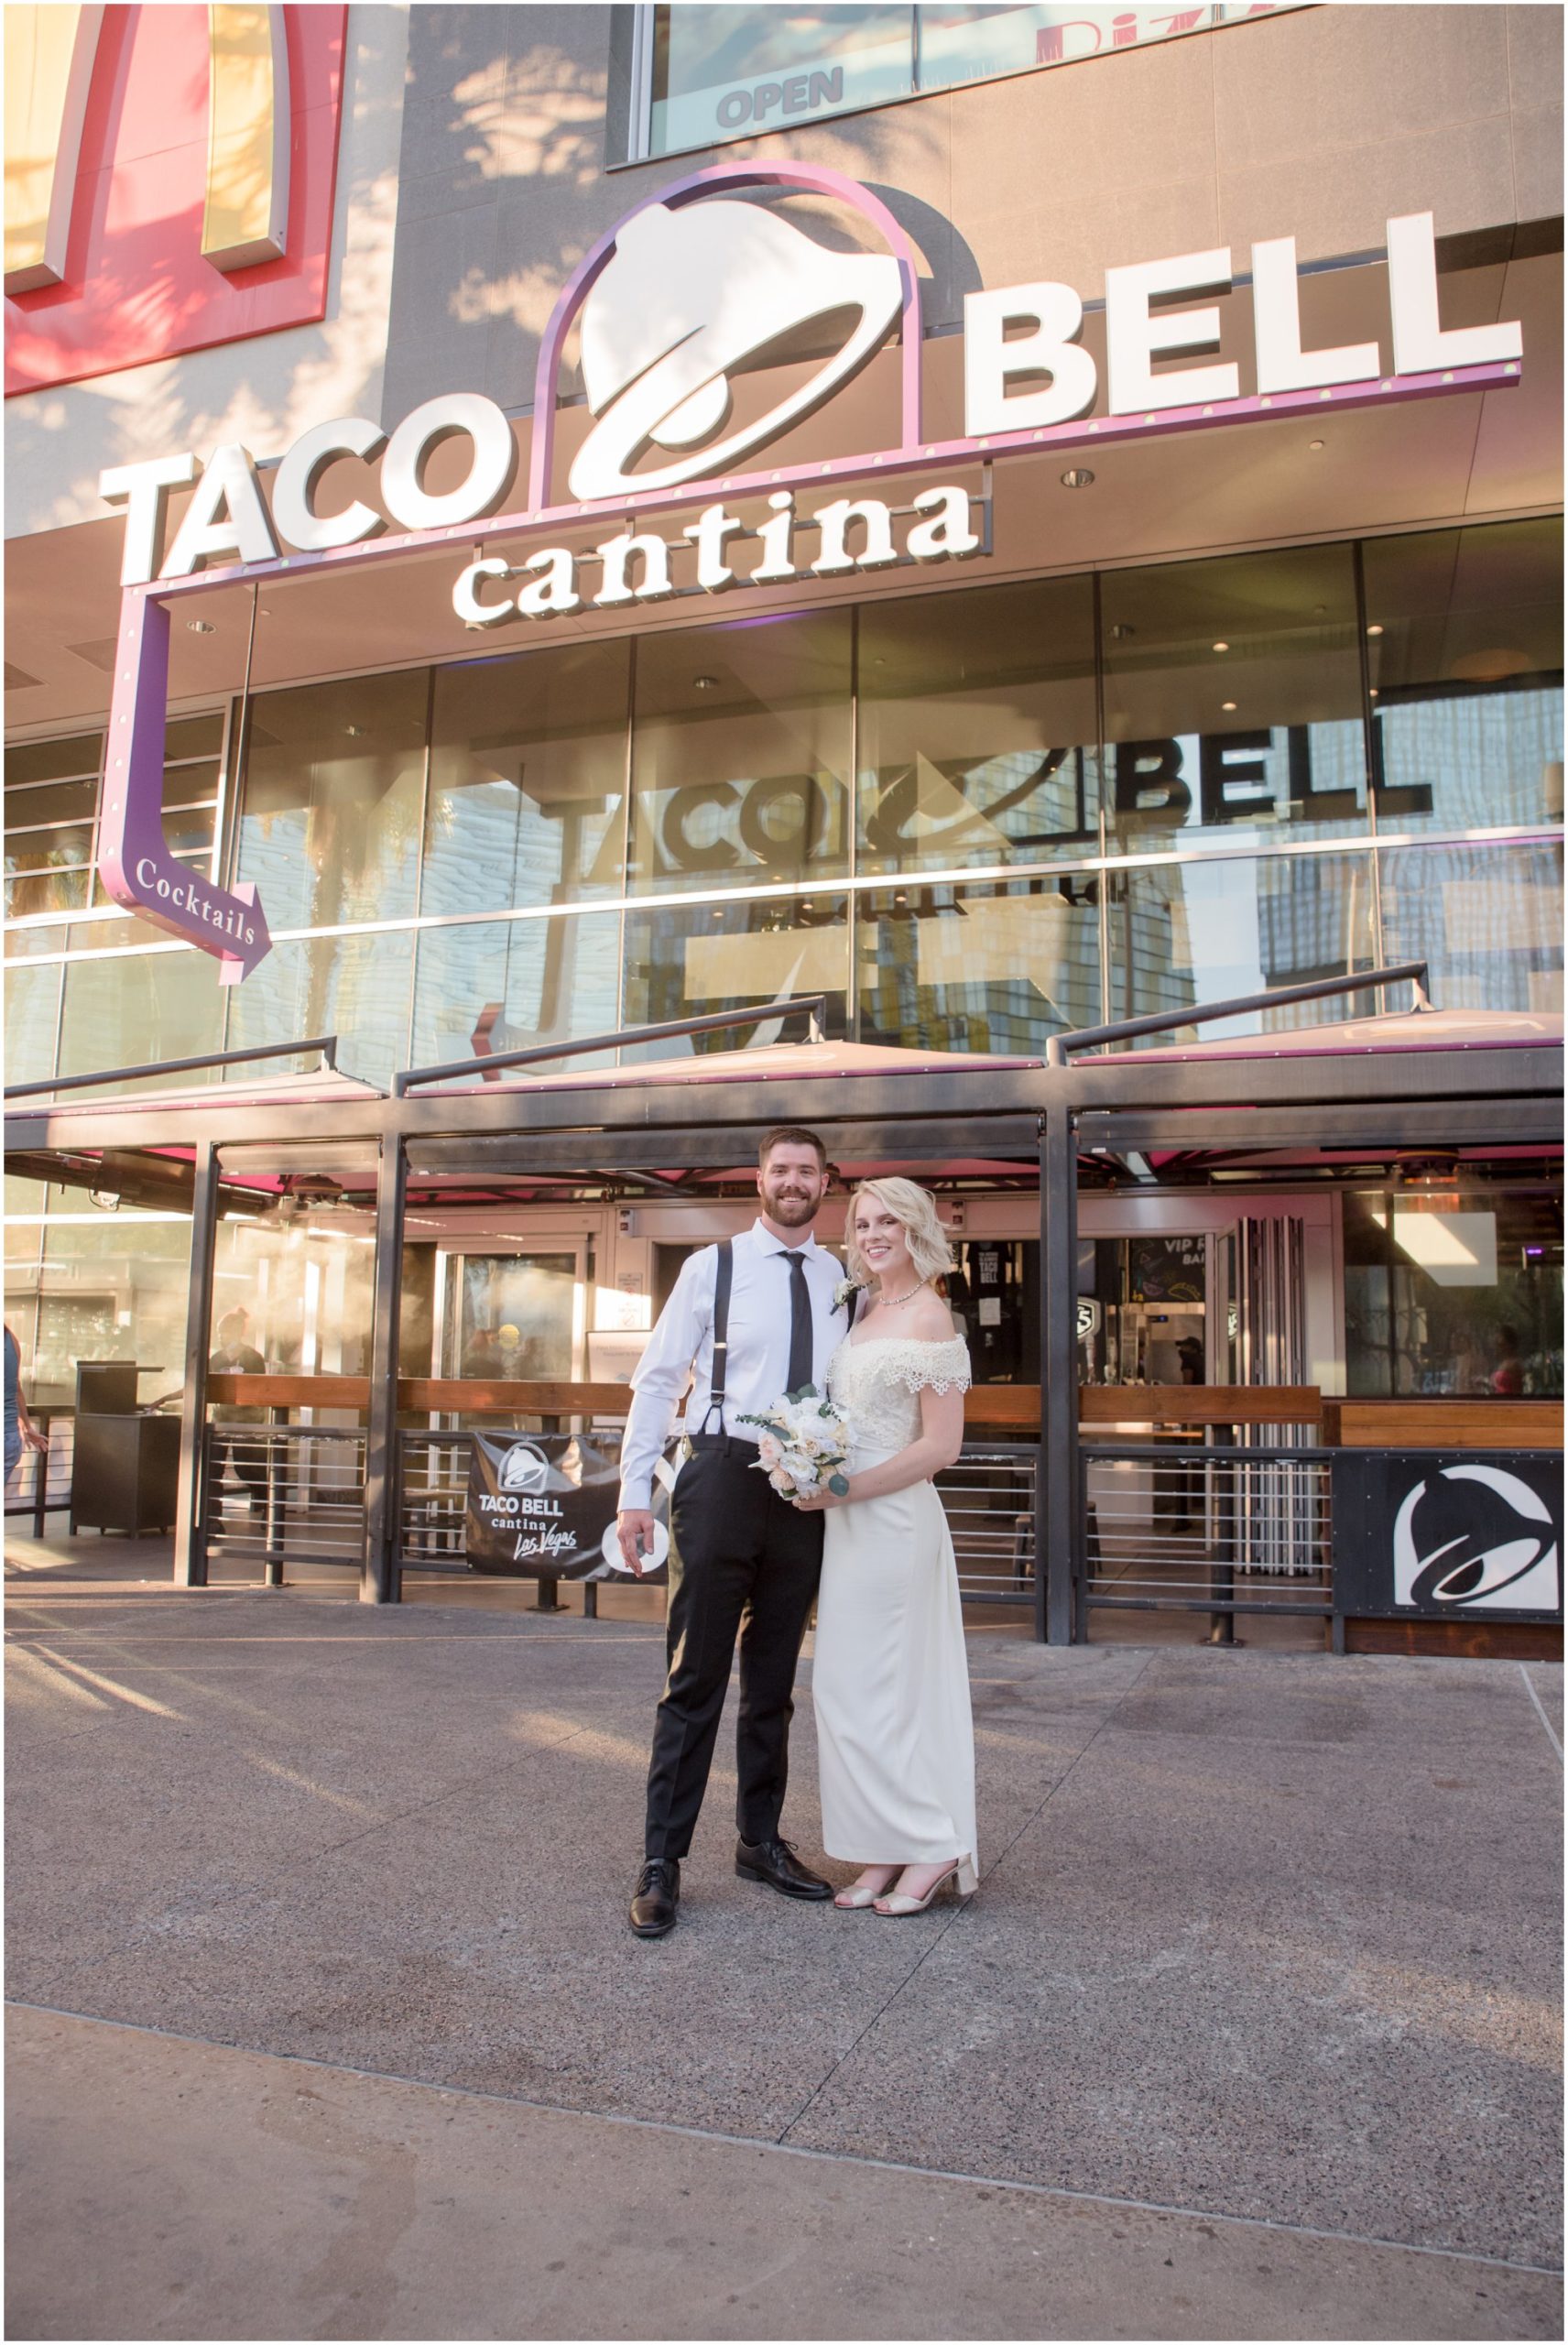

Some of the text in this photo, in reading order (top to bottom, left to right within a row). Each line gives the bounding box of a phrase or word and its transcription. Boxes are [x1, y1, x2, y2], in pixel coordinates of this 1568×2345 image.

[716, 66, 844, 128] OPEN
[98, 211, 1524, 587] TACO BELL
[452, 485, 980, 628] cantina
[136, 858, 255, 944] Cocktails
[1165, 1238, 1192, 1253] VIP
[479, 1494, 563, 1517] TACO BELL
[491, 1518, 547, 1531] cantina
[514, 1522, 577, 1561] Las Vegas
